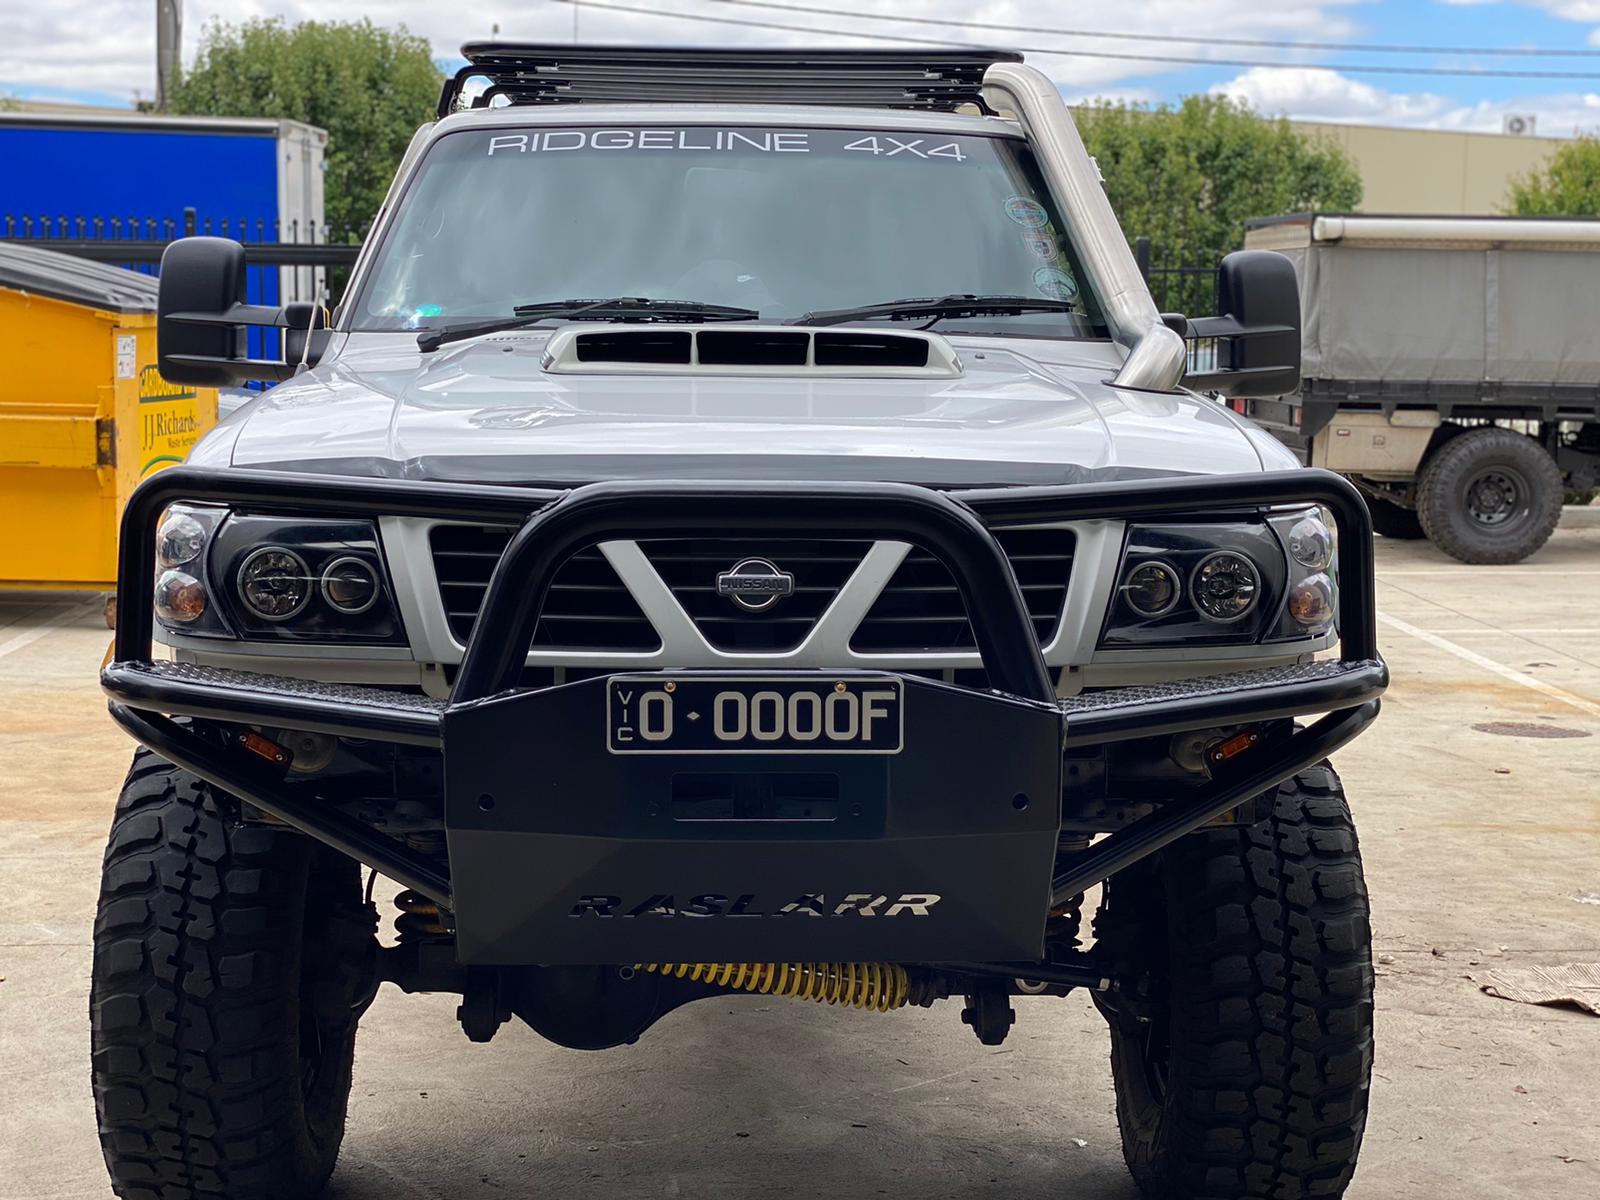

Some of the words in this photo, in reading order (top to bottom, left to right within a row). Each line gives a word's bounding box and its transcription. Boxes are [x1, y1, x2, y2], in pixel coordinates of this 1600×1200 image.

[487, 129, 810, 155] RIDGELINE
[843, 135, 967, 162] 4X4
[727, 579, 783, 591] NISSAN
[567, 893, 942, 918] RASLARR
